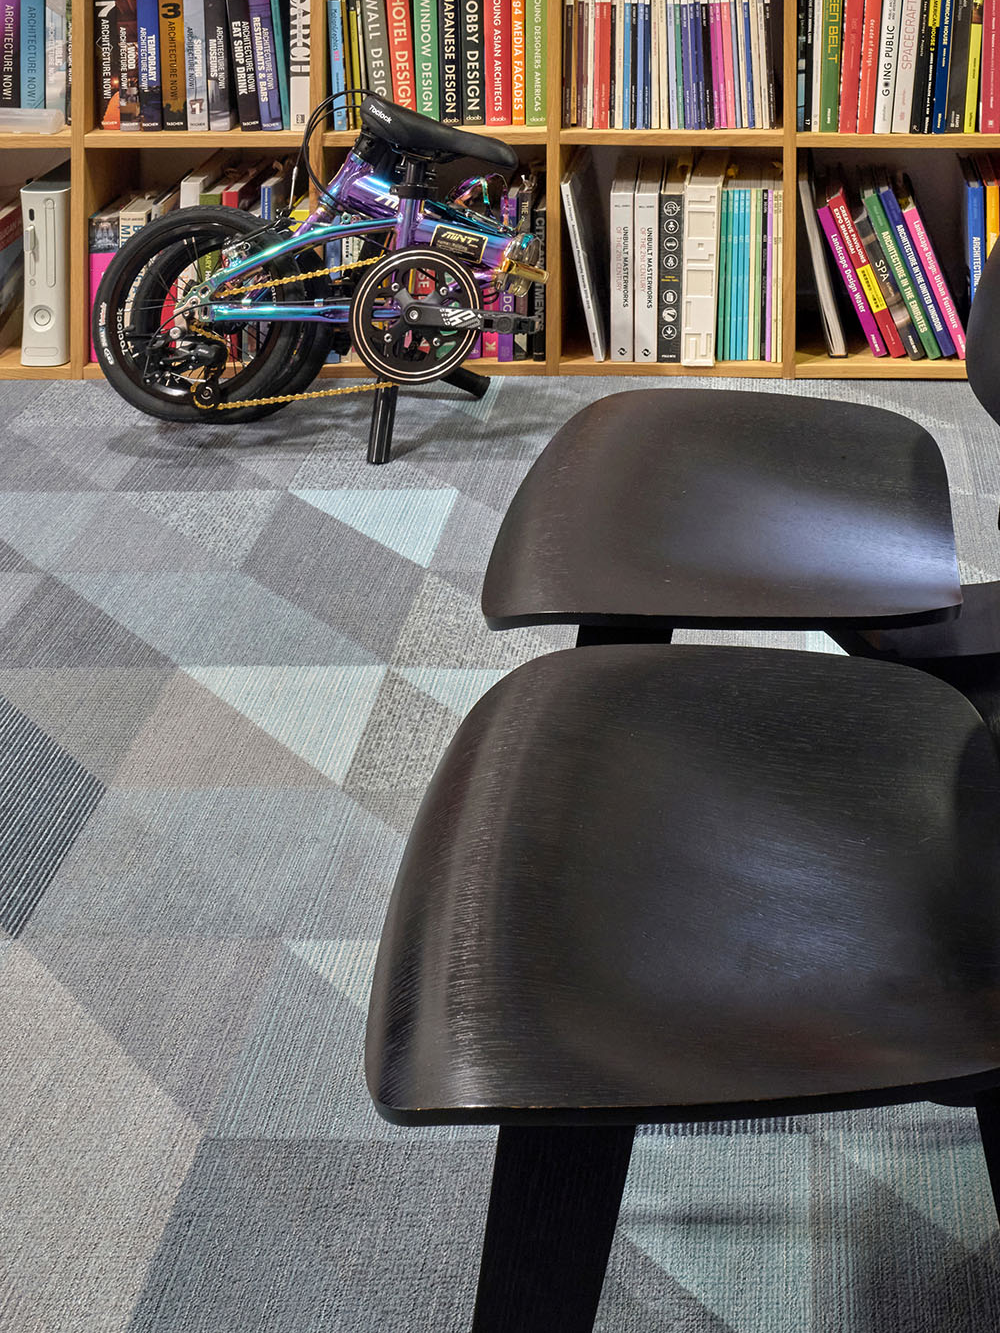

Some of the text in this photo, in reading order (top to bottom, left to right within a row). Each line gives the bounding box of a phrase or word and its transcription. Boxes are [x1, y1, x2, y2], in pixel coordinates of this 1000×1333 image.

[95, 1, 117, 17] 7
[161, 2, 181, 19] 3
[2, 5, 14, 100] ARCHITECTURE NOW!
[493, 29, 502, 57] ASIAN
[513, 20, 523, 56] MEDIA
[533, 23, 542, 69] DESIGNERS
[827, 25, 839, 64] BELT
[942, 25, 951, 45] HOUSE
[127, 46, 136, 69] WOOD
[147, 34, 157, 81] TEMPORARY
[193, 38, 202, 77] SHOPPING
[208, 38, 217, 78] MUSEUMS
[231, 20, 248, 96] EAT SHOP DRINK
[252, 16, 265, 71] RESTAURANTS
[259, 80, 269, 103] BARS
[371, 48, 387, 97] DESIG
[395, 50, 412, 110] DESIGN
[421, 63, 433, 112] DESIGN
[444, 65, 456, 113] DESIGN
[466, 50, 480, 111] DESIGN
[494, 59, 503, 112] ARCHITECTS
[513, 60, 523, 111] FACADES
[534, 71, 543, 112] AMERICAS
[521, 200, 529, 215] THE
[833, 208, 856, 255] EXPO SHANGHAI
[838, 205, 867, 263] CREATIVE PAVILIONS
[895, 224, 918, 267] ARCHITECTURE
[829, 233, 867, 313] Landscape Design Water
[875, 259, 890, 282] SPA
[880, 230, 906, 278] ARCHITECTURE
[912, 220, 961, 329] Landscape Design: Urban Furniture
[904, 286, 915, 300] THE
[915, 272, 925, 284] THE
[919, 282, 933, 305] UNITED
[909, 299, 928, 333] EMIRATES
[927, 303, 944, 332] KINGDOM
